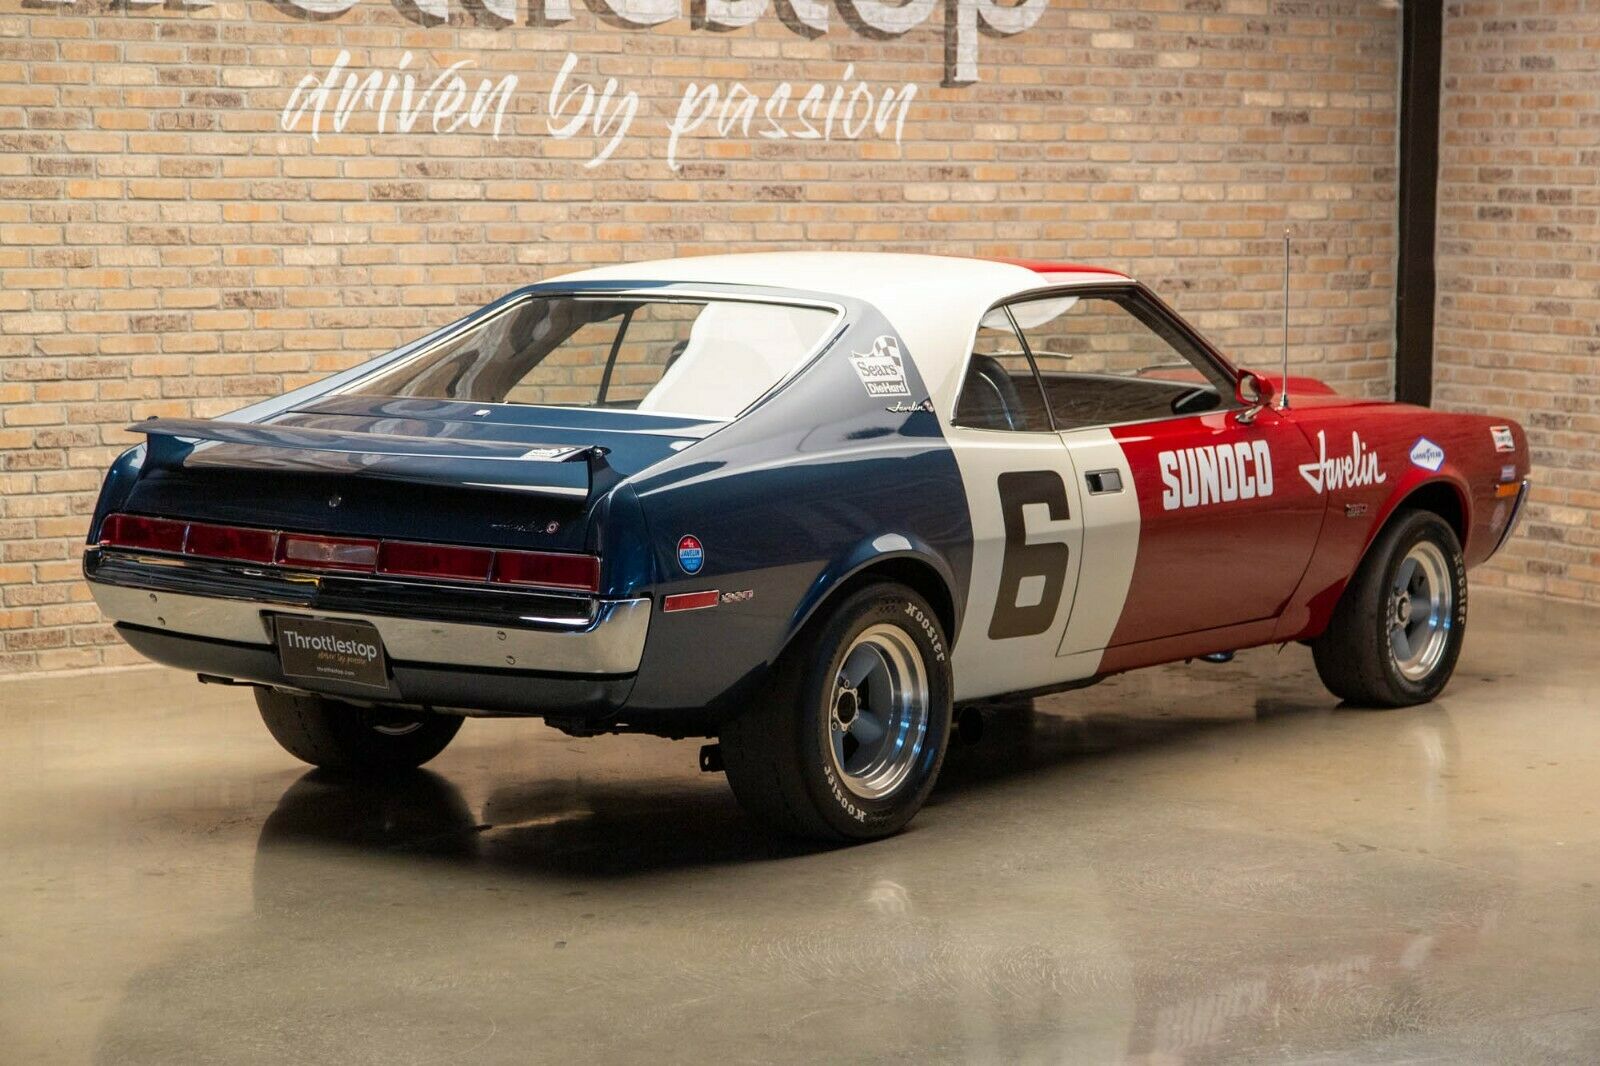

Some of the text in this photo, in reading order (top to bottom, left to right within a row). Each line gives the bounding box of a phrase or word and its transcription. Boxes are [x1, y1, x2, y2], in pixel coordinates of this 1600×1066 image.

[281, 49, 917, 171] driven by passion
[856, 360, 899, 377] Sears
[867, 381, 907, 394] DieHard
[1158, 439, 1274, 511] SUNOCO
[1298, 429, 1387, 494] Javelin
[987, 470, 1071, 640] 6
[283, 630, 378, 661] Throttlestop
[904, 602, 945, 661] Hoosier
[823, 766, 867, 824] Hoosier
